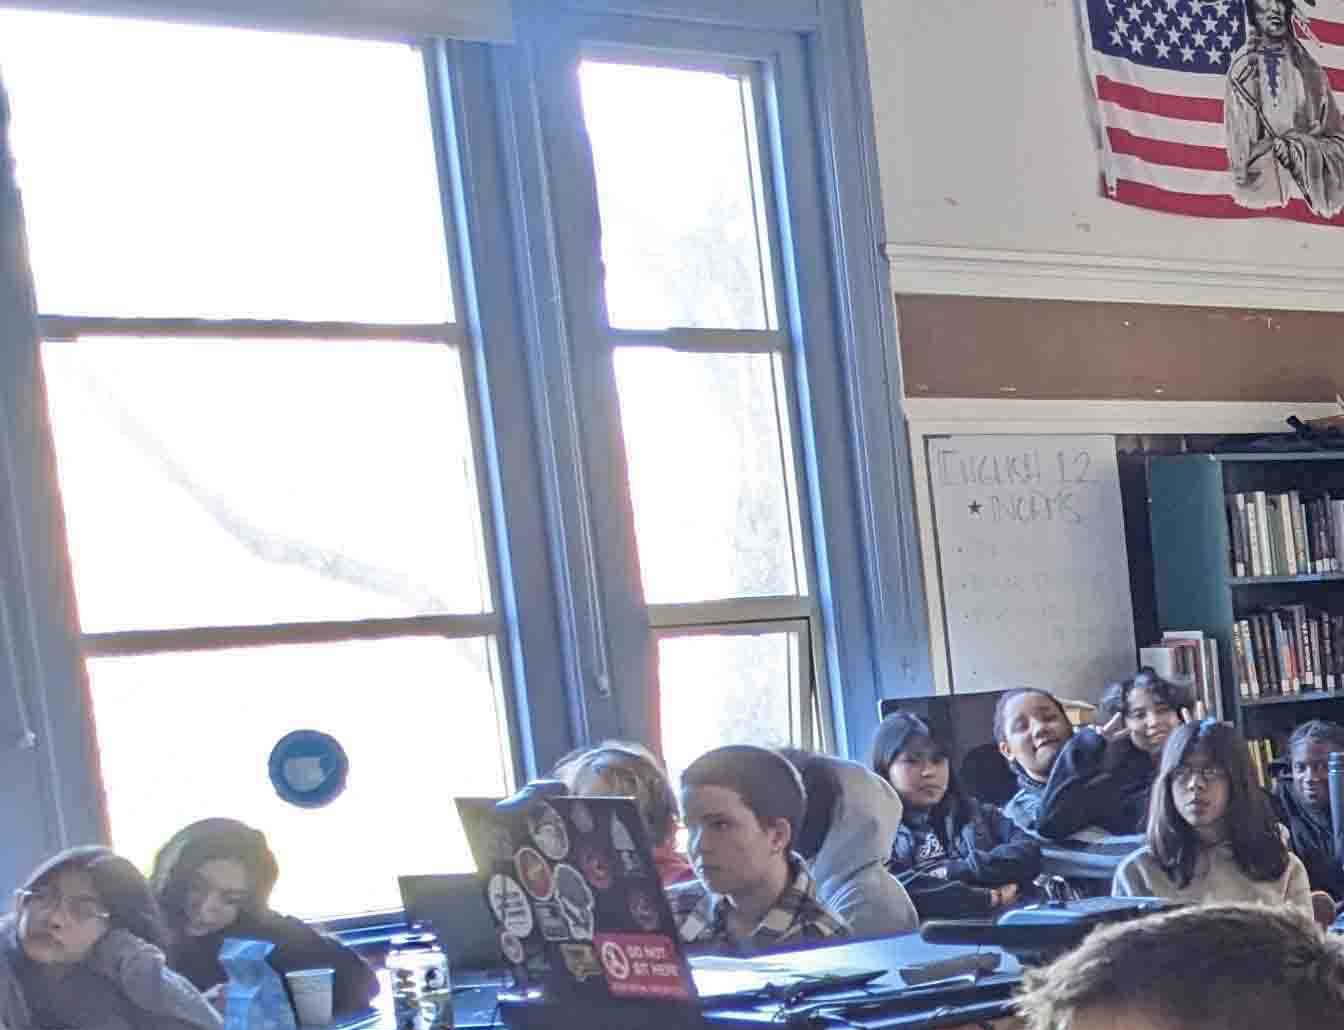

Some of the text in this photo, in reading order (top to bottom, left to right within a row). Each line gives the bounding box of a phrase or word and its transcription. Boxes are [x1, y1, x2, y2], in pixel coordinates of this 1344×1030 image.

[935, 446, 1092, 488] ENGLISH 12
[650, 961, 680, 977] HERE
